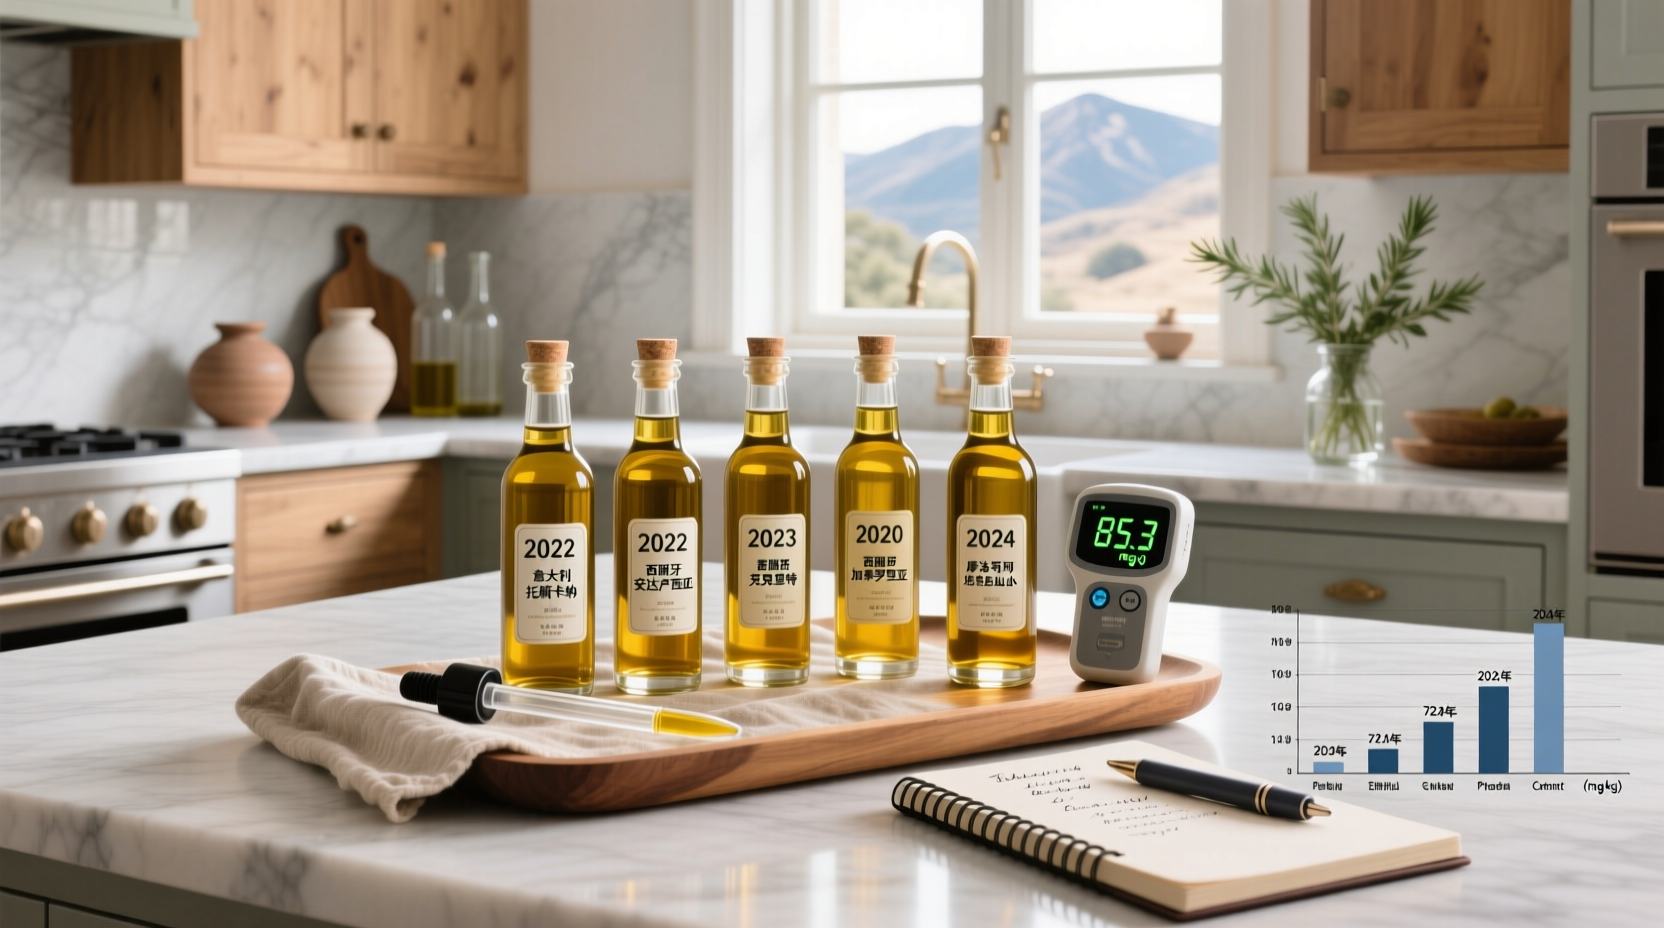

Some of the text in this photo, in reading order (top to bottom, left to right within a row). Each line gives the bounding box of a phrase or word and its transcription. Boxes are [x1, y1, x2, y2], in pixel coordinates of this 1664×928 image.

[638, 532, 688, 553] 2022
[748, 529, 798, 548] 2023
[856, 525, 903, 544] 2020
[966, 529, 1016, 548] 2024
[1094, 517, 1158, 551] 85.3
[524, 538, 575, 559] 2022
